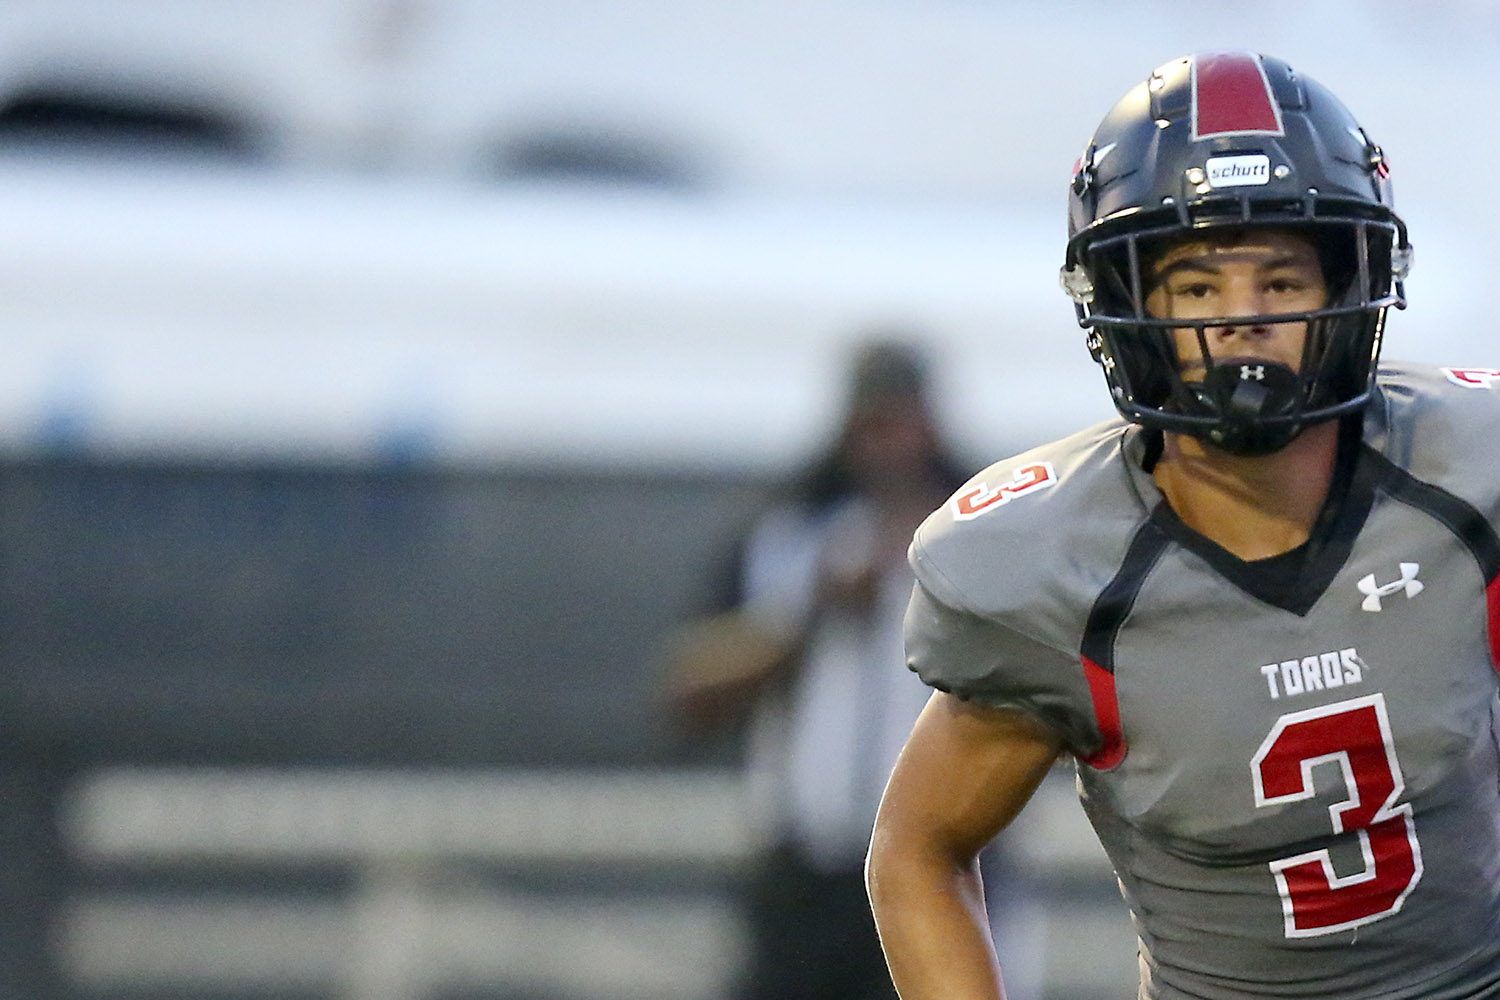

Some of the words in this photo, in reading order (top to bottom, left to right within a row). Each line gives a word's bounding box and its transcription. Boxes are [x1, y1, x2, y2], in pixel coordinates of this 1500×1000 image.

[1210, 163, 1268, 180] schutt
[950, 461, 1058, 522] 3
[1260, 648, 1363, 699] TOROS
[1250, 692, 1424, 938] 3
